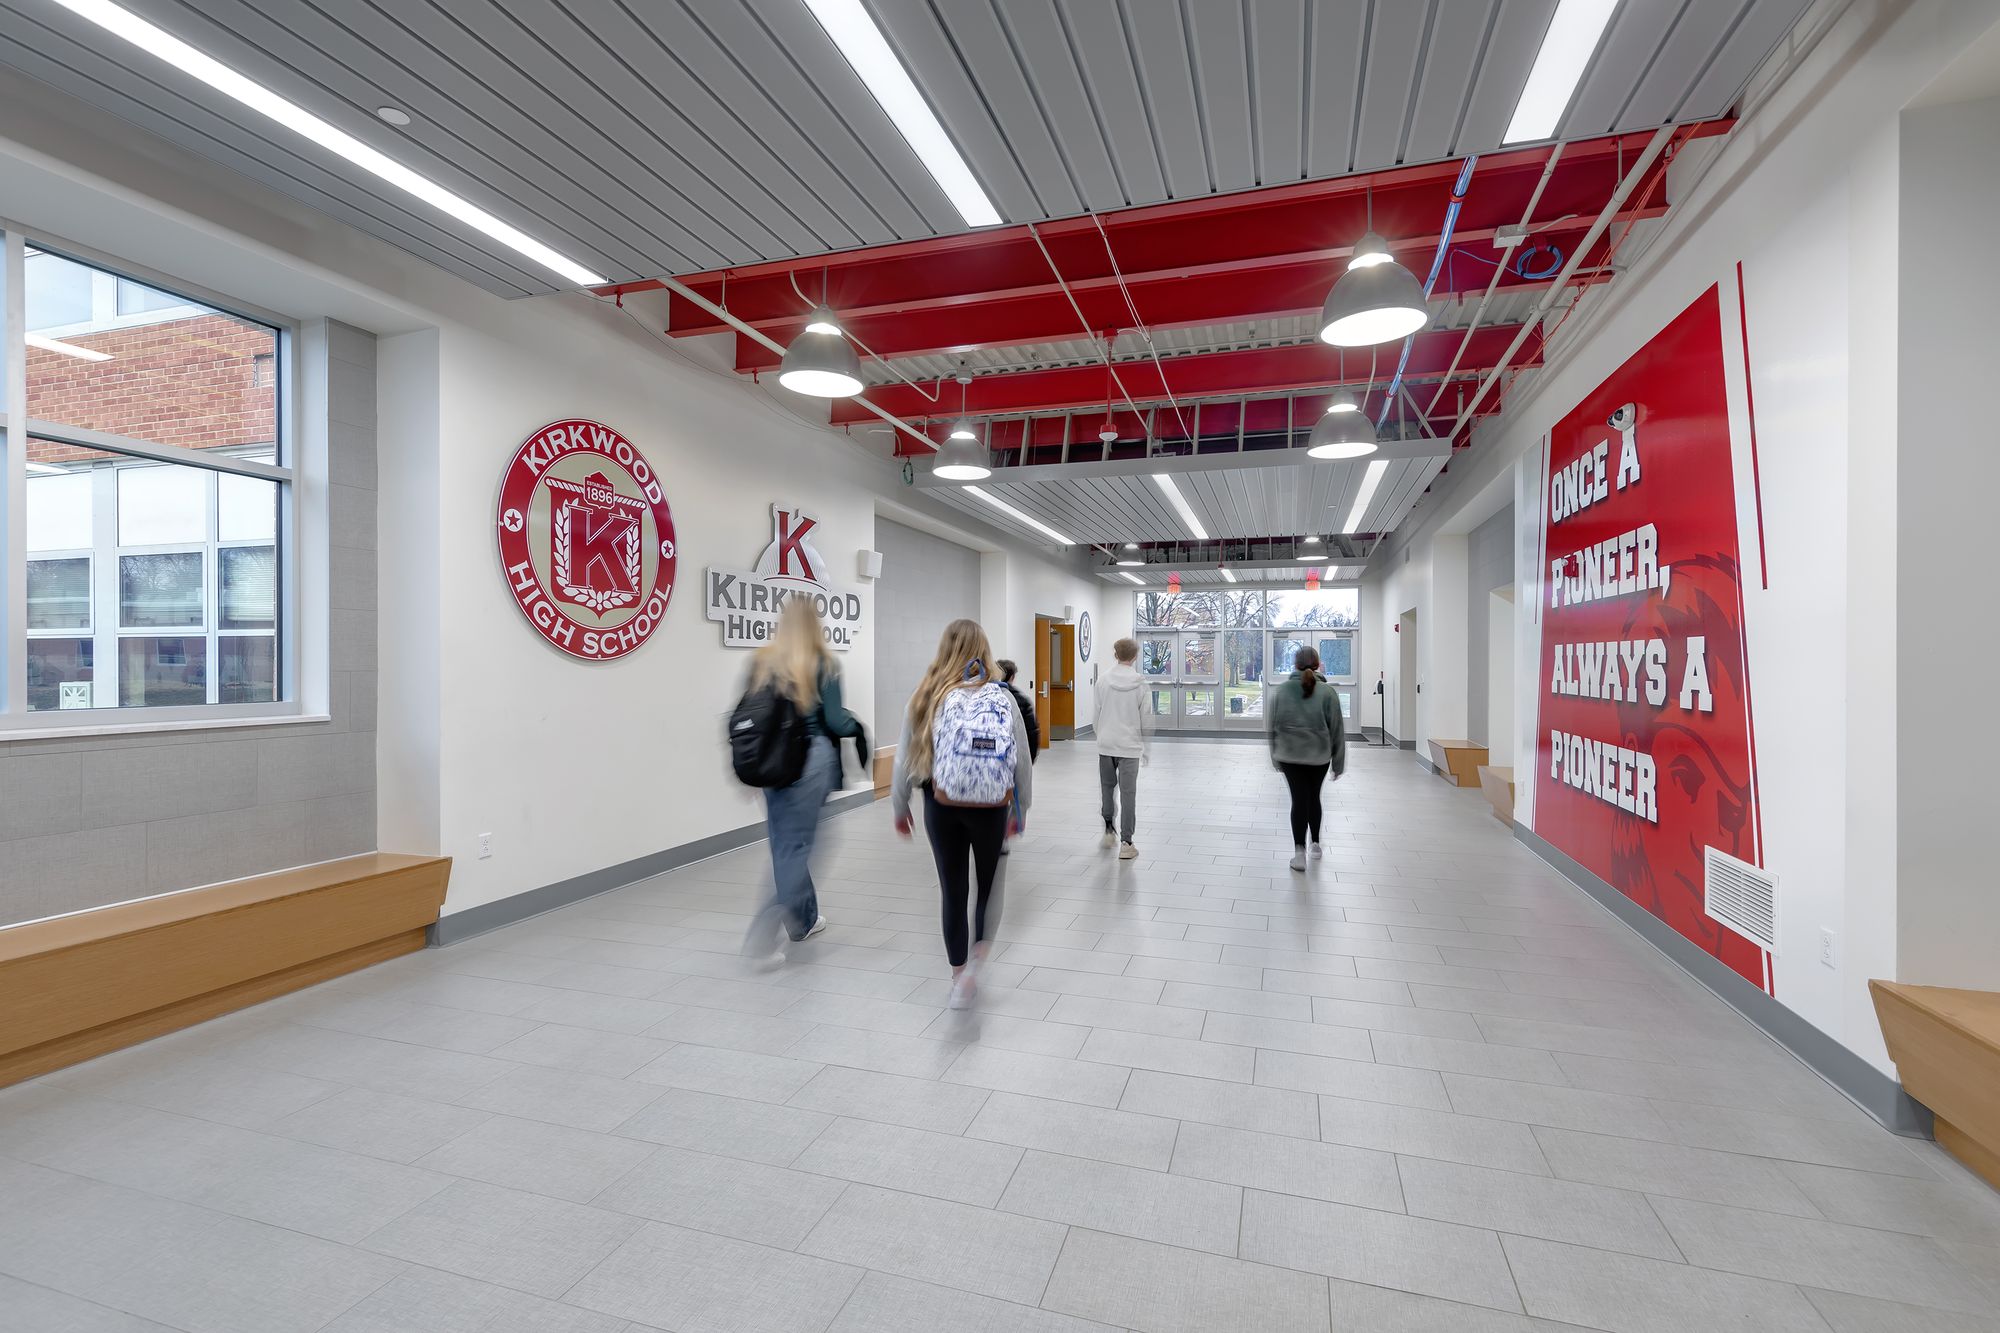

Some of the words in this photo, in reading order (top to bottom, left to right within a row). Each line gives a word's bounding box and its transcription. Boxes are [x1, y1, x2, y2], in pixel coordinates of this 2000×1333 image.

[521, 425, 662, 505] KIRKWOOD
[586, 487, 613, 504] 1896
[1551, 438, 1608, 523] ONCE
[1616, 424, 1641, 490] A
[565, 503, 640, 596] K
[778, 510, 817, 581] K
[509, 560, 576, 646] HIGH
[582, 583, 672, 654] SCHOOL
[728, 614, 778, 641] HIGH
[1551, 638, 1667, 706] ALWAYS
[1679, 635, 1713, 712] A
[1551, 729, 1658, 824] PIONEER
